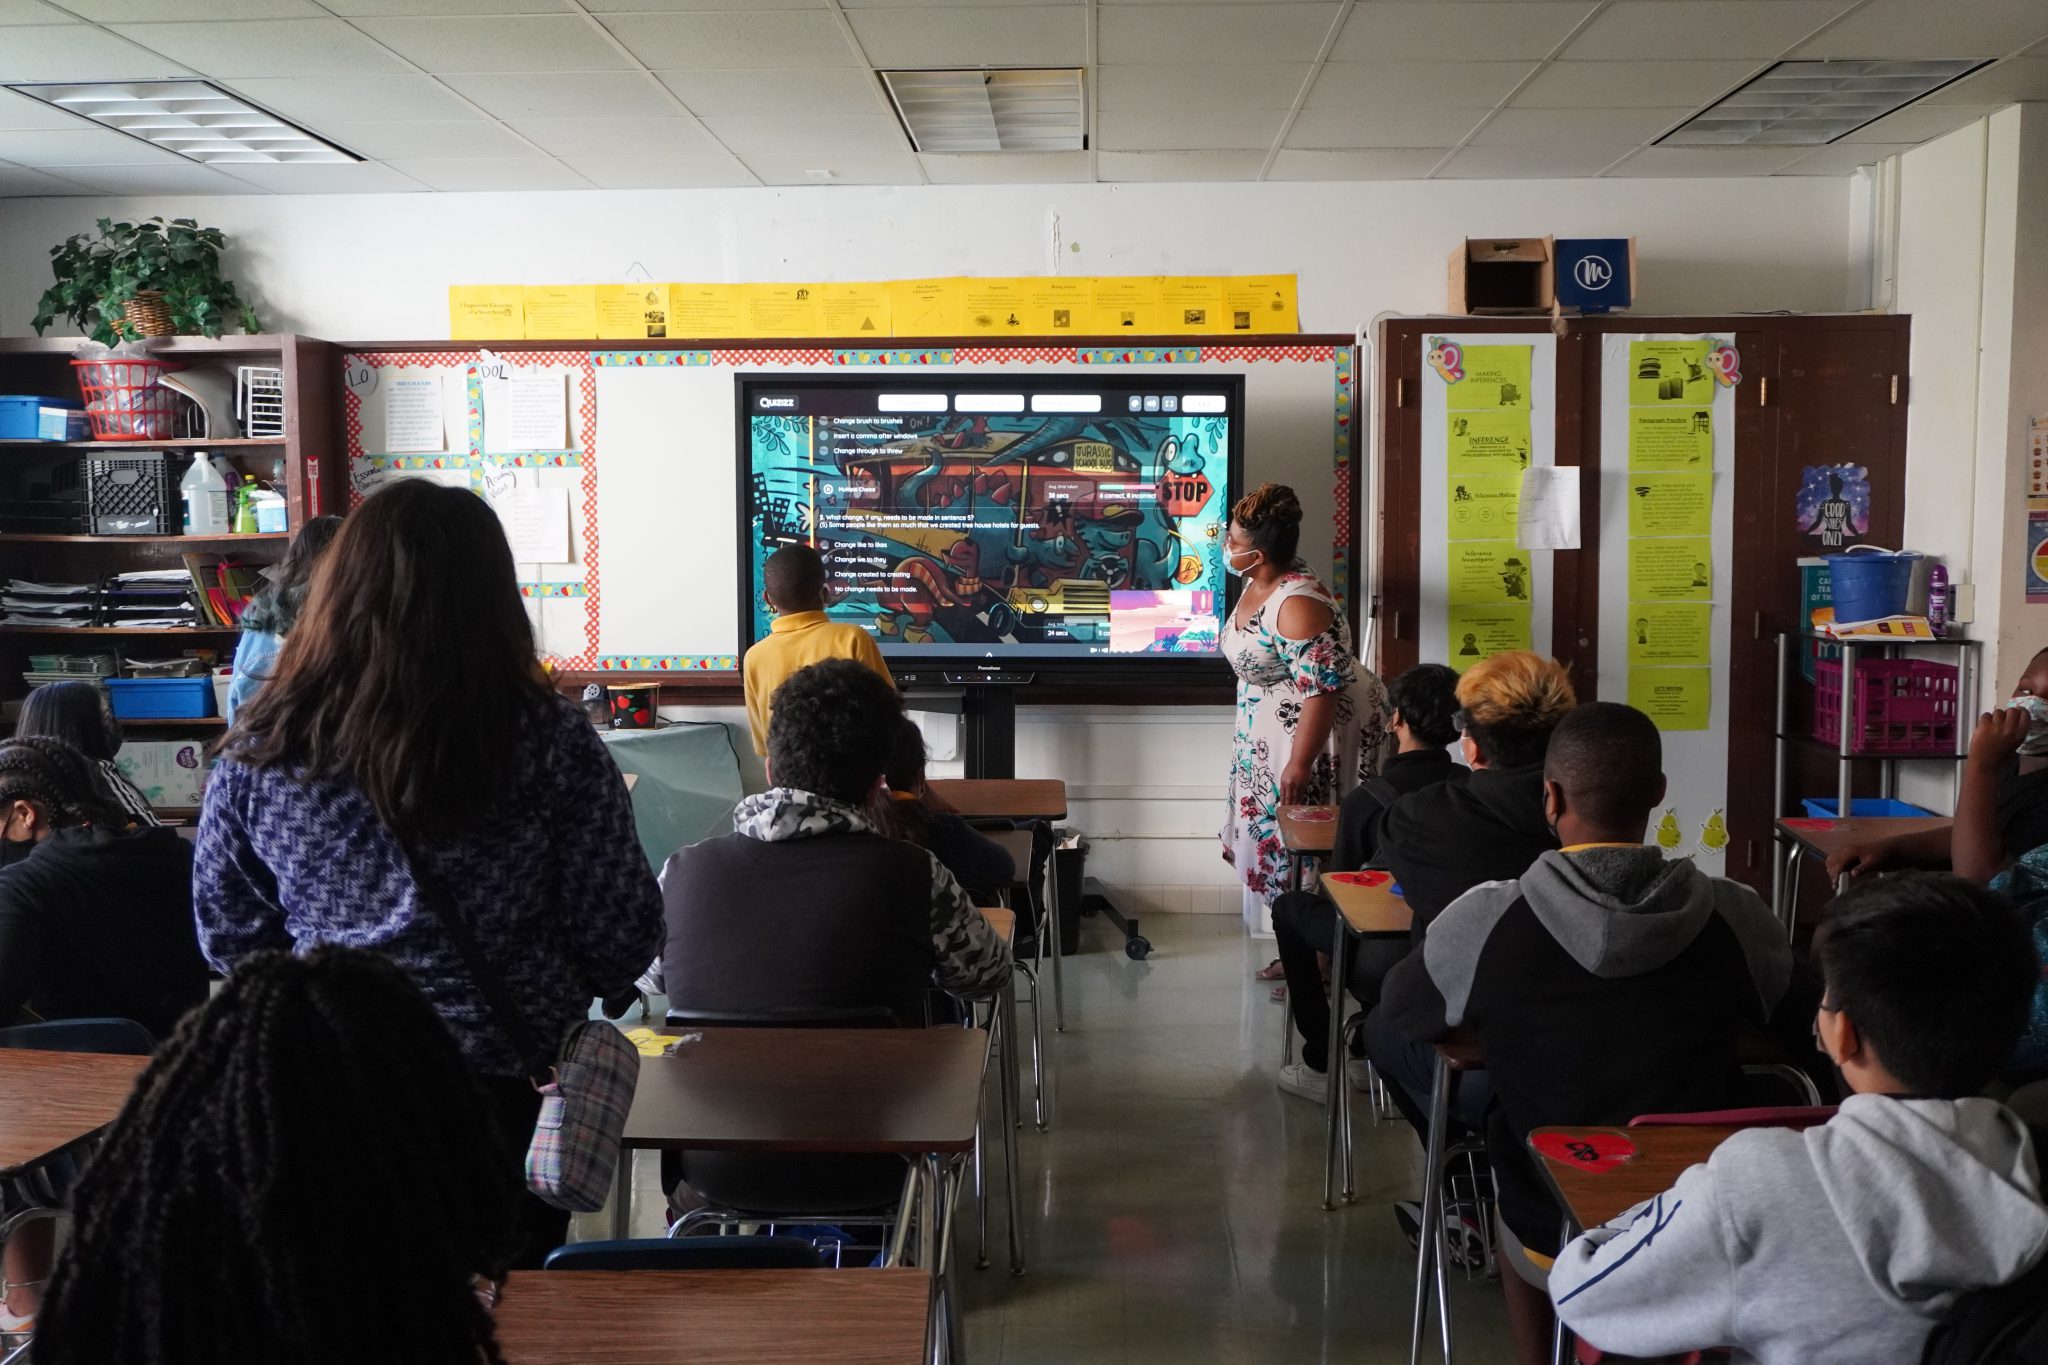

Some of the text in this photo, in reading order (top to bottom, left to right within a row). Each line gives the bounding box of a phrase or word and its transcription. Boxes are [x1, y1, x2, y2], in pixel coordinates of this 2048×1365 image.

[348, 369, 368, 387] LO
[481, 364, 508, 379] DOL
[833, 448, 903, 456] Change through to threw
[1076, 445, 1112, 457] JURASSIC
[1100, 459, 1112, 469] BUS
[1163, 482, 1208, 502] STOP
[1825, 503, 1845, 517] GOOD
[1823, 531, 1841, 546] ONLY
